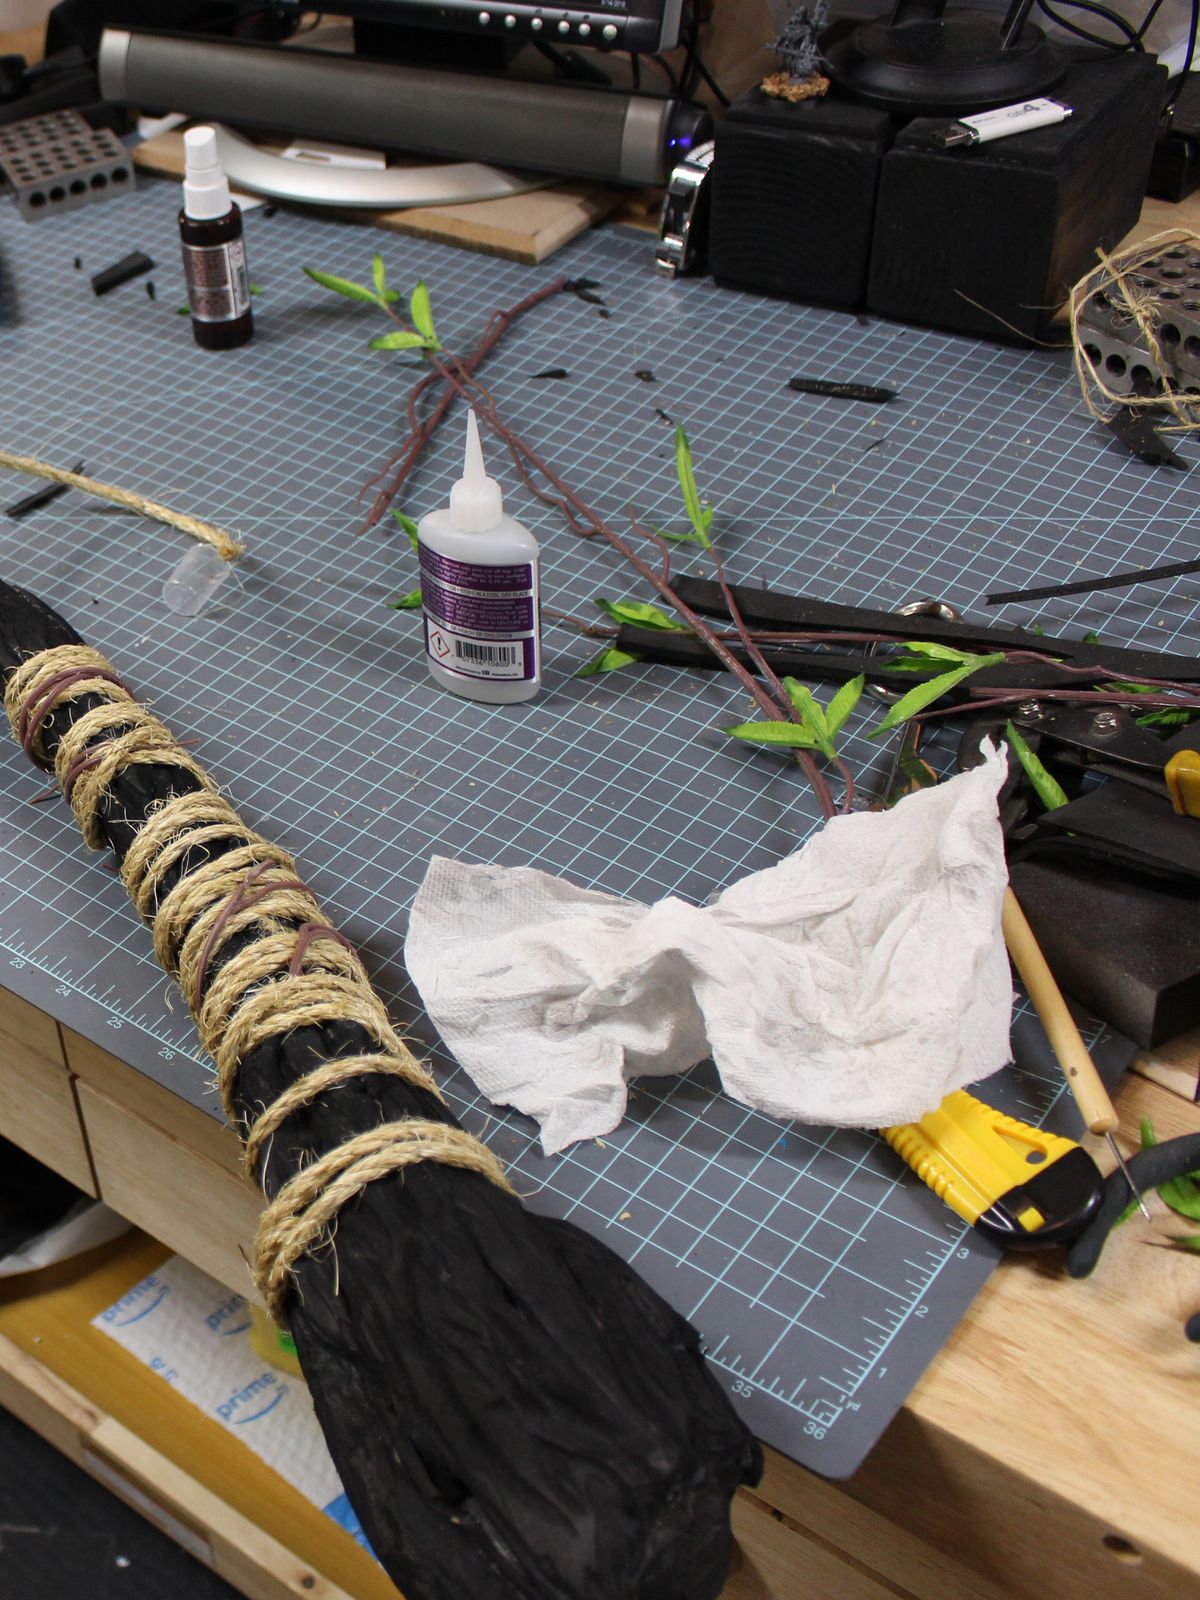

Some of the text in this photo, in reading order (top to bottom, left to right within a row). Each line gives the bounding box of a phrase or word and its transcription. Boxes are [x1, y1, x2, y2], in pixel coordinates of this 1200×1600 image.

[9, 957, 26, 969] 23
[55, 984, 72, 998] 24
[106, 1016, 125, 1030] 25
[157, 1047, 176, 1061] 26
[956, 1247, 970, 1259] 3
[102, 1275, 161, 1323] prime
[914, 1305, 929, 1319] 2
[878, 1367, 888, 1379] 1
[731, 1379, 755, 1399] 35
[215, 1371, 278, 1422] prime
[803, 1421, 828, 1440] 36
